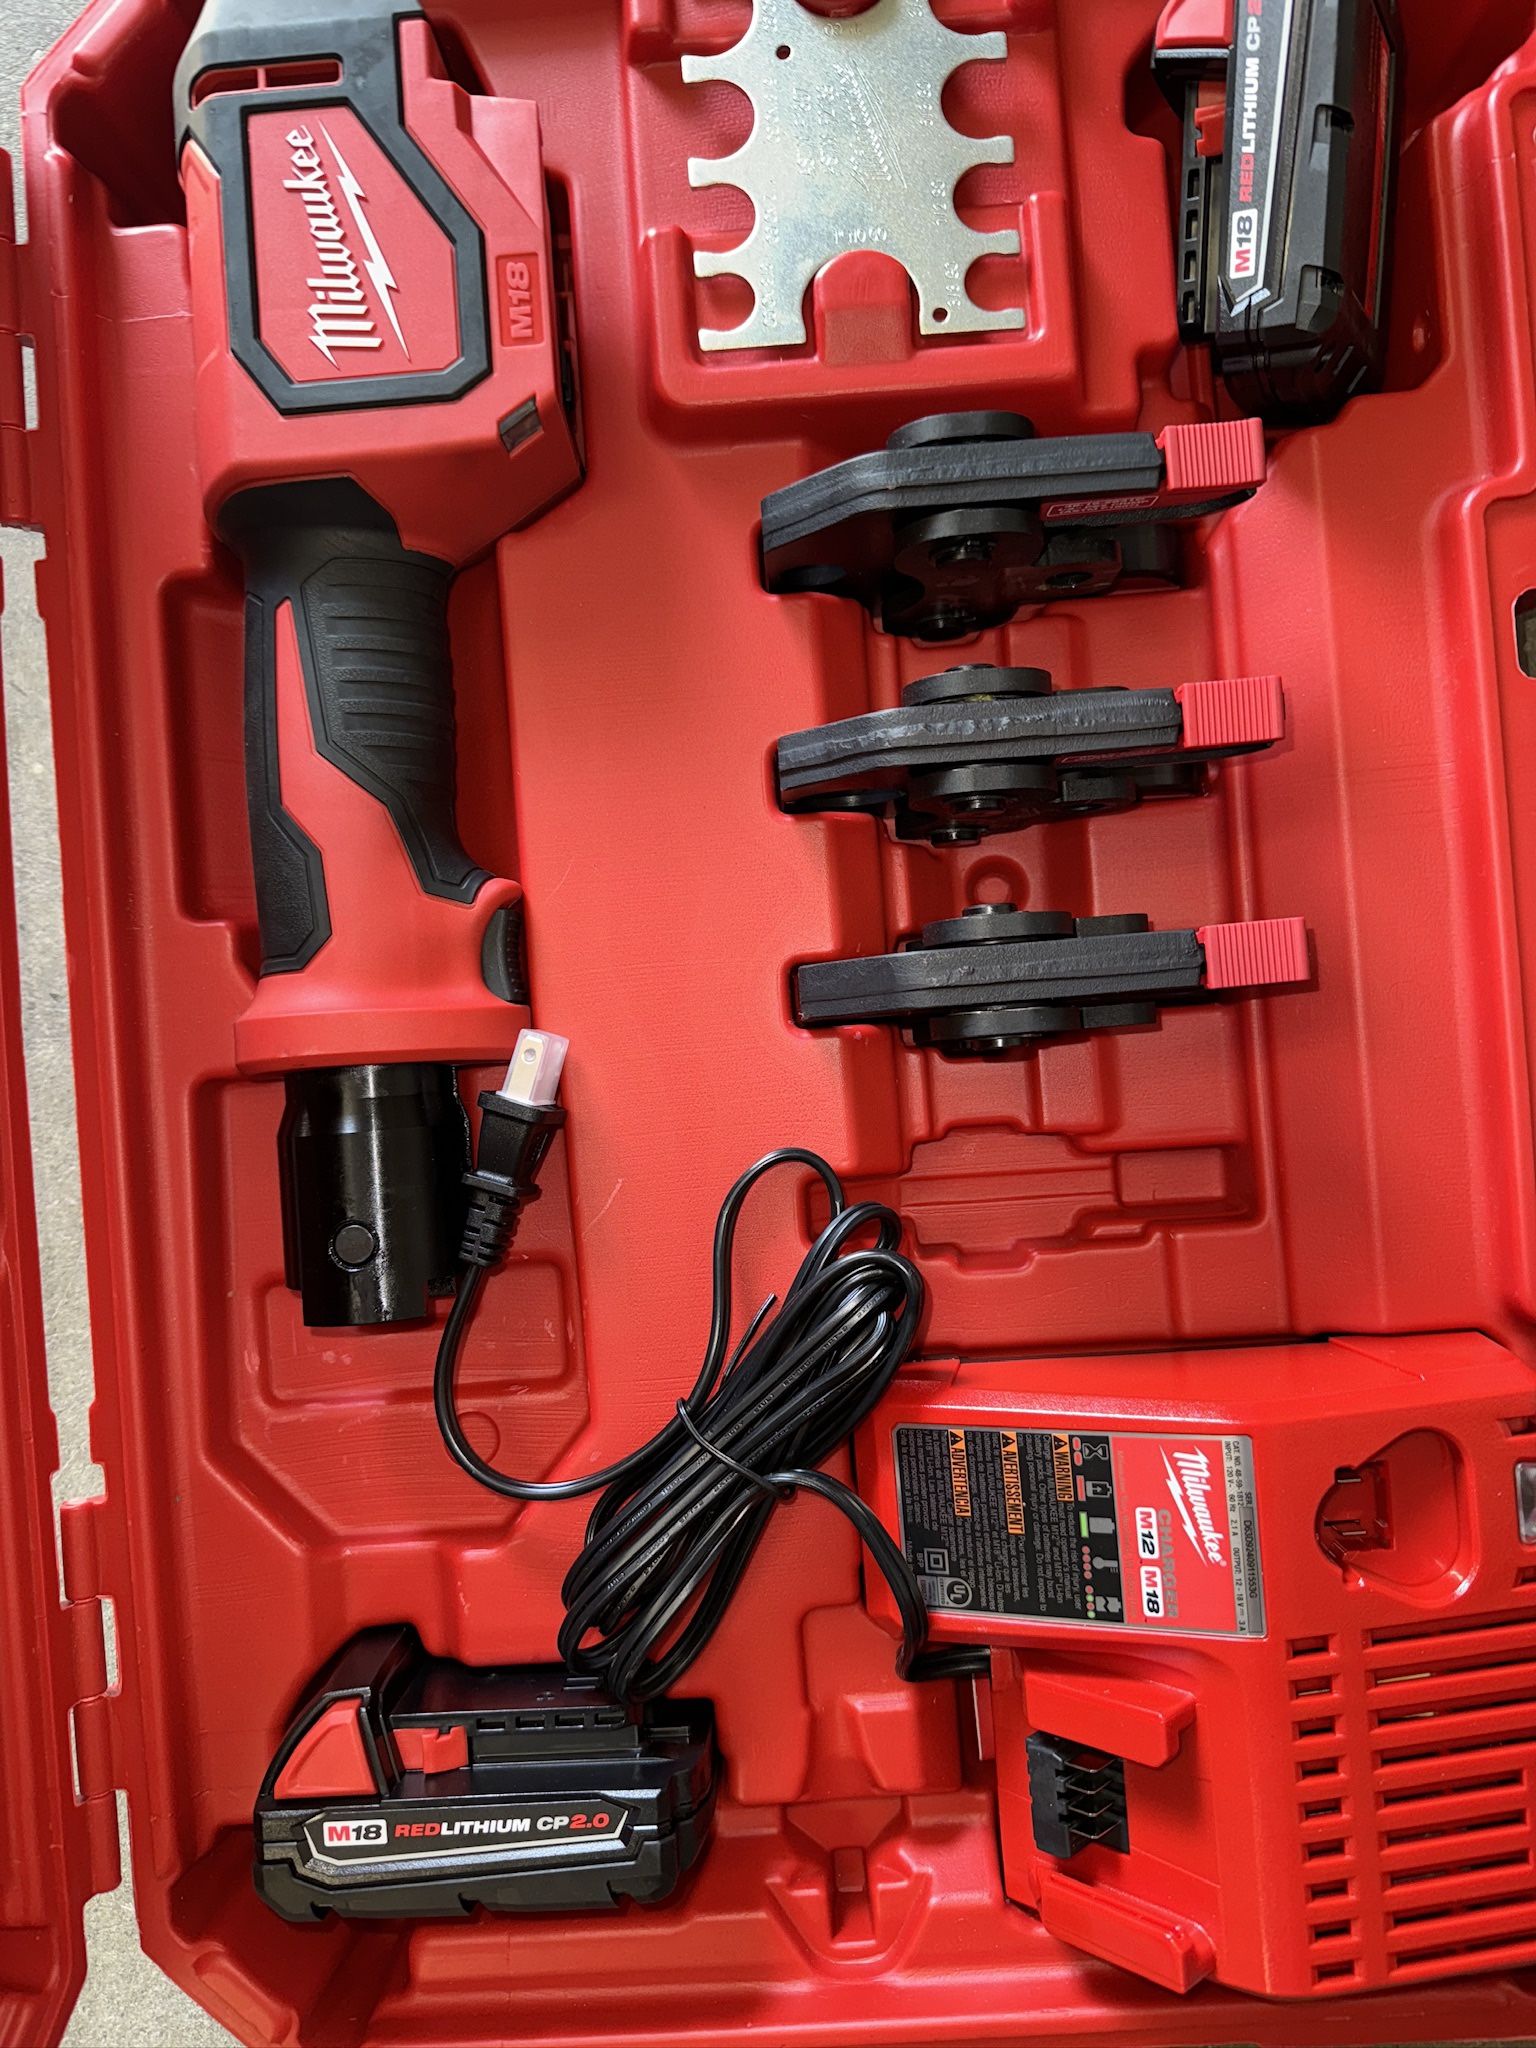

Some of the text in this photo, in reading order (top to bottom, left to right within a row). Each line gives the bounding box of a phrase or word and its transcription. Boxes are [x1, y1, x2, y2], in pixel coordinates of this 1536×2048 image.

[1239, 57, 1260, 202] REDLITHIUM
[282, 124, 384, 372] Milwaukee
[1234, 215, 1253, 273] M18
[506, 261, 534, 339] M18
[951, 1447, 969, 1513] ADVERTENCIA
[1002, 1450, 1022, 1531] AVERTISSEMENT
[1054, 1451, 1072, 1499] WARNING
[1172, 1446, 1225, 1563] Milwaukee
[1139, 1510, 1160, 1614] M12 M18
[1157, 1508, 1178, 1618] CHARGER
[328, 1812, 610, 1842] M18 REDLITHIUM CP2.0
